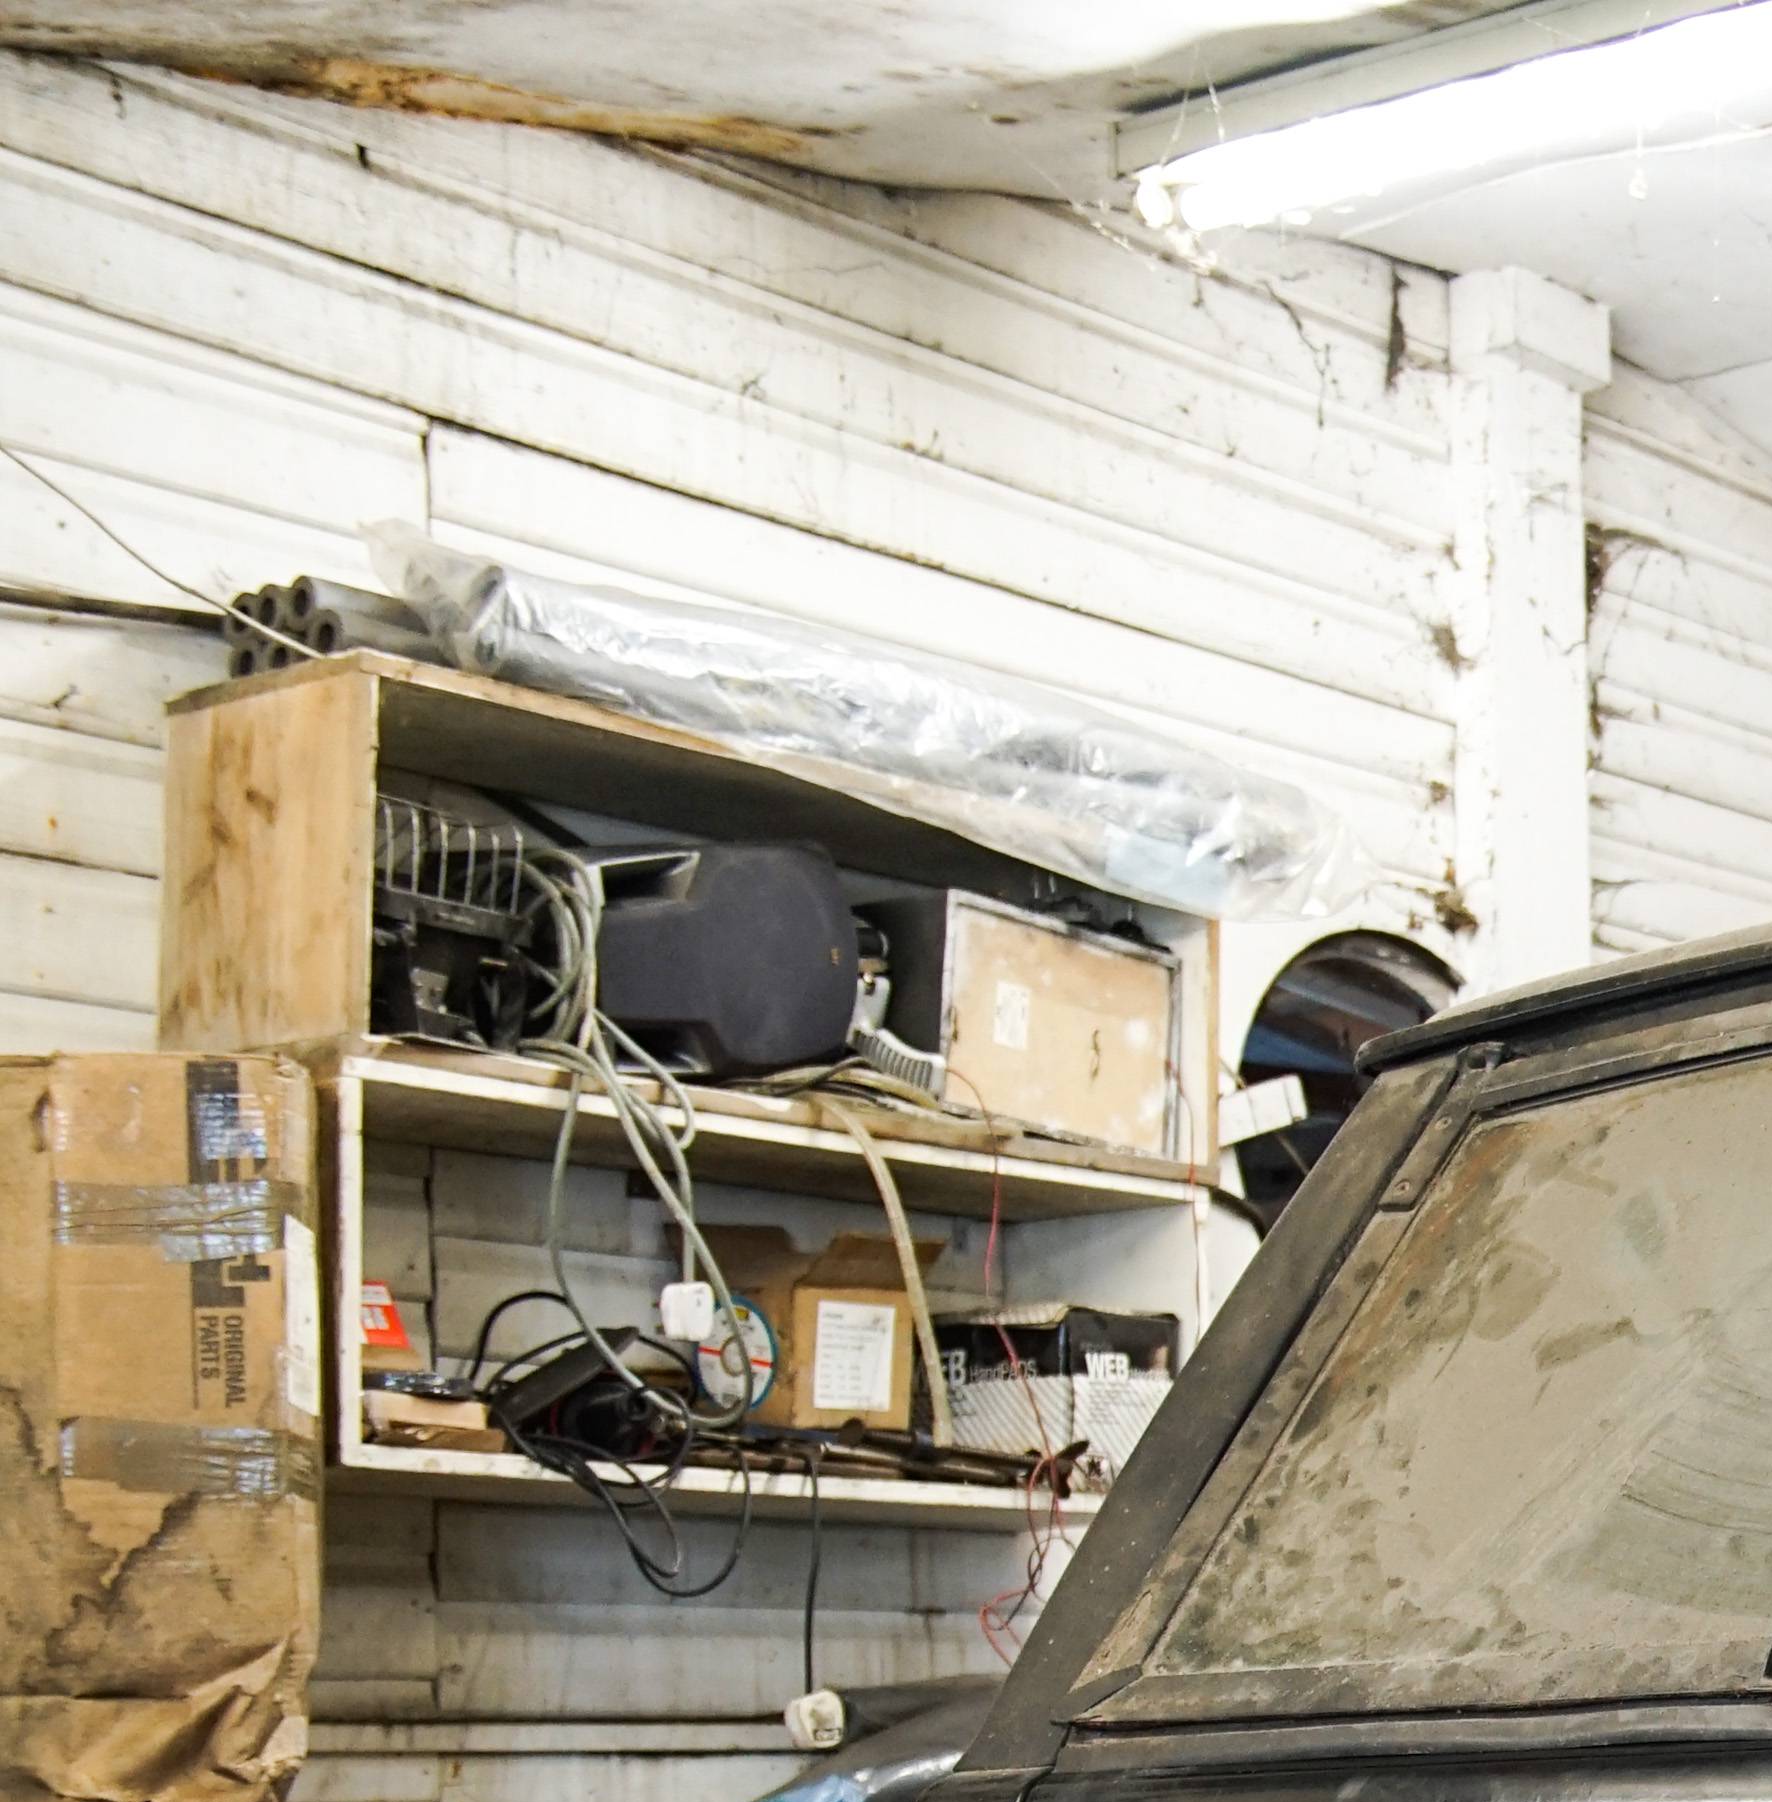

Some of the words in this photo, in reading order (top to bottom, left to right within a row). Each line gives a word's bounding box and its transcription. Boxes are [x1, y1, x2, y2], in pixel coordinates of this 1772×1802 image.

[199, 1315, 220, 1379] PARTS
[225, 1315, 246, 1408] ORIGINAL
[1085, 1352, 1130, 1382] WEB
